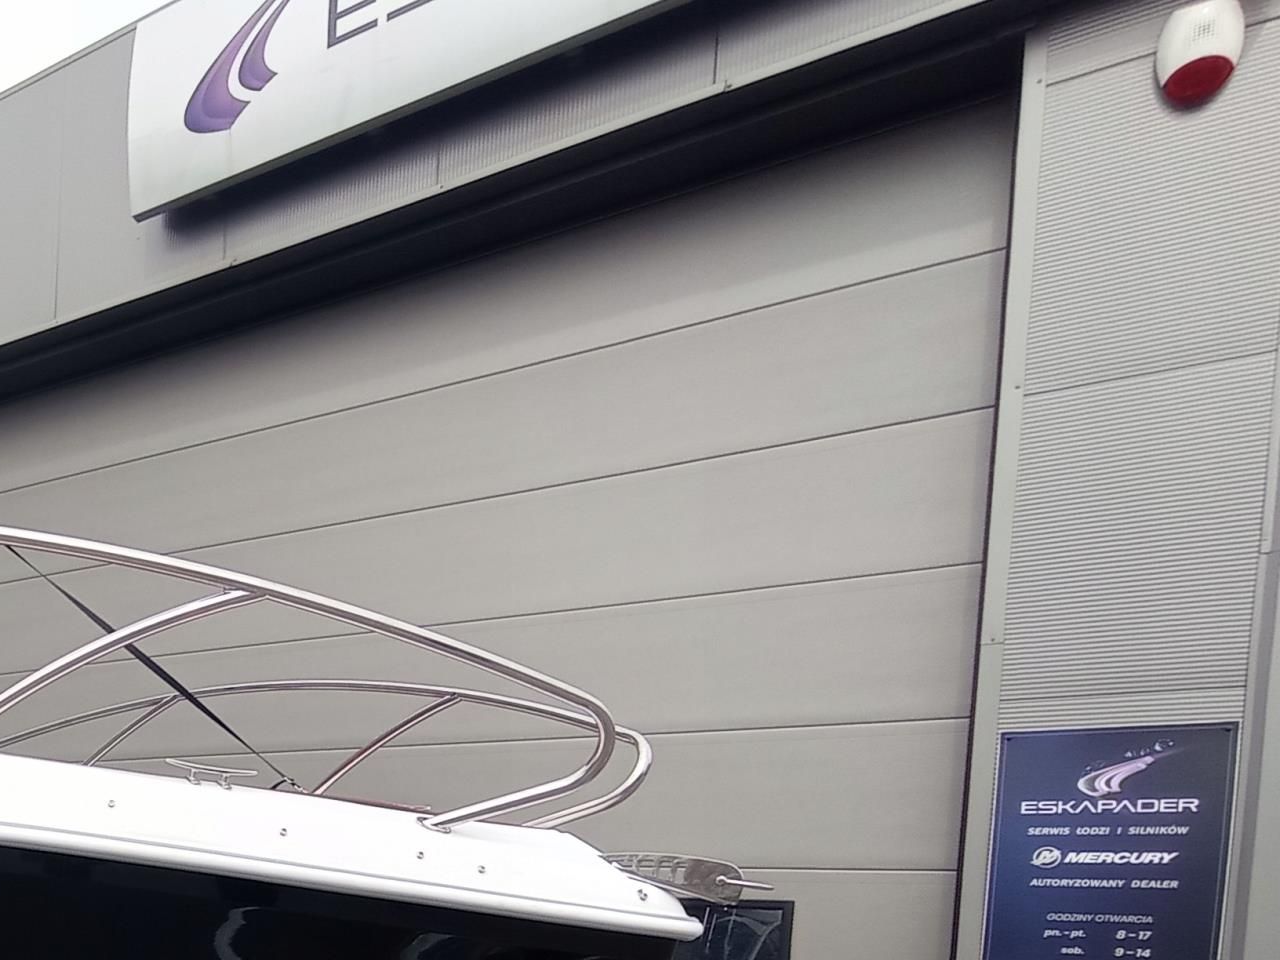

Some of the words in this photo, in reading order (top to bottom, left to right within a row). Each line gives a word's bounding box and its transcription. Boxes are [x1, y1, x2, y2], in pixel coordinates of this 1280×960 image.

[1020, 798, 1200, 815] ESKAPADER
[1026, 826, 1071, 836] SERWIS
[1075, 826, 1111, 836] ŁODZI
[1116, 827, 1122, 836] I
[1127, 824, 1190, 836] SILNIKÓW
[1063, 851, 1180, 865] MERCURY
[1029, 878, 1126, 888] AUTORYZOWANY
[1130, 879, 1180, 889] DEALER
[1045, 912, 1095, 922] GODZINY
[1094, 914, 1154, 924] OTWARCIA
[1060, 946, 1086, 955] sob.
